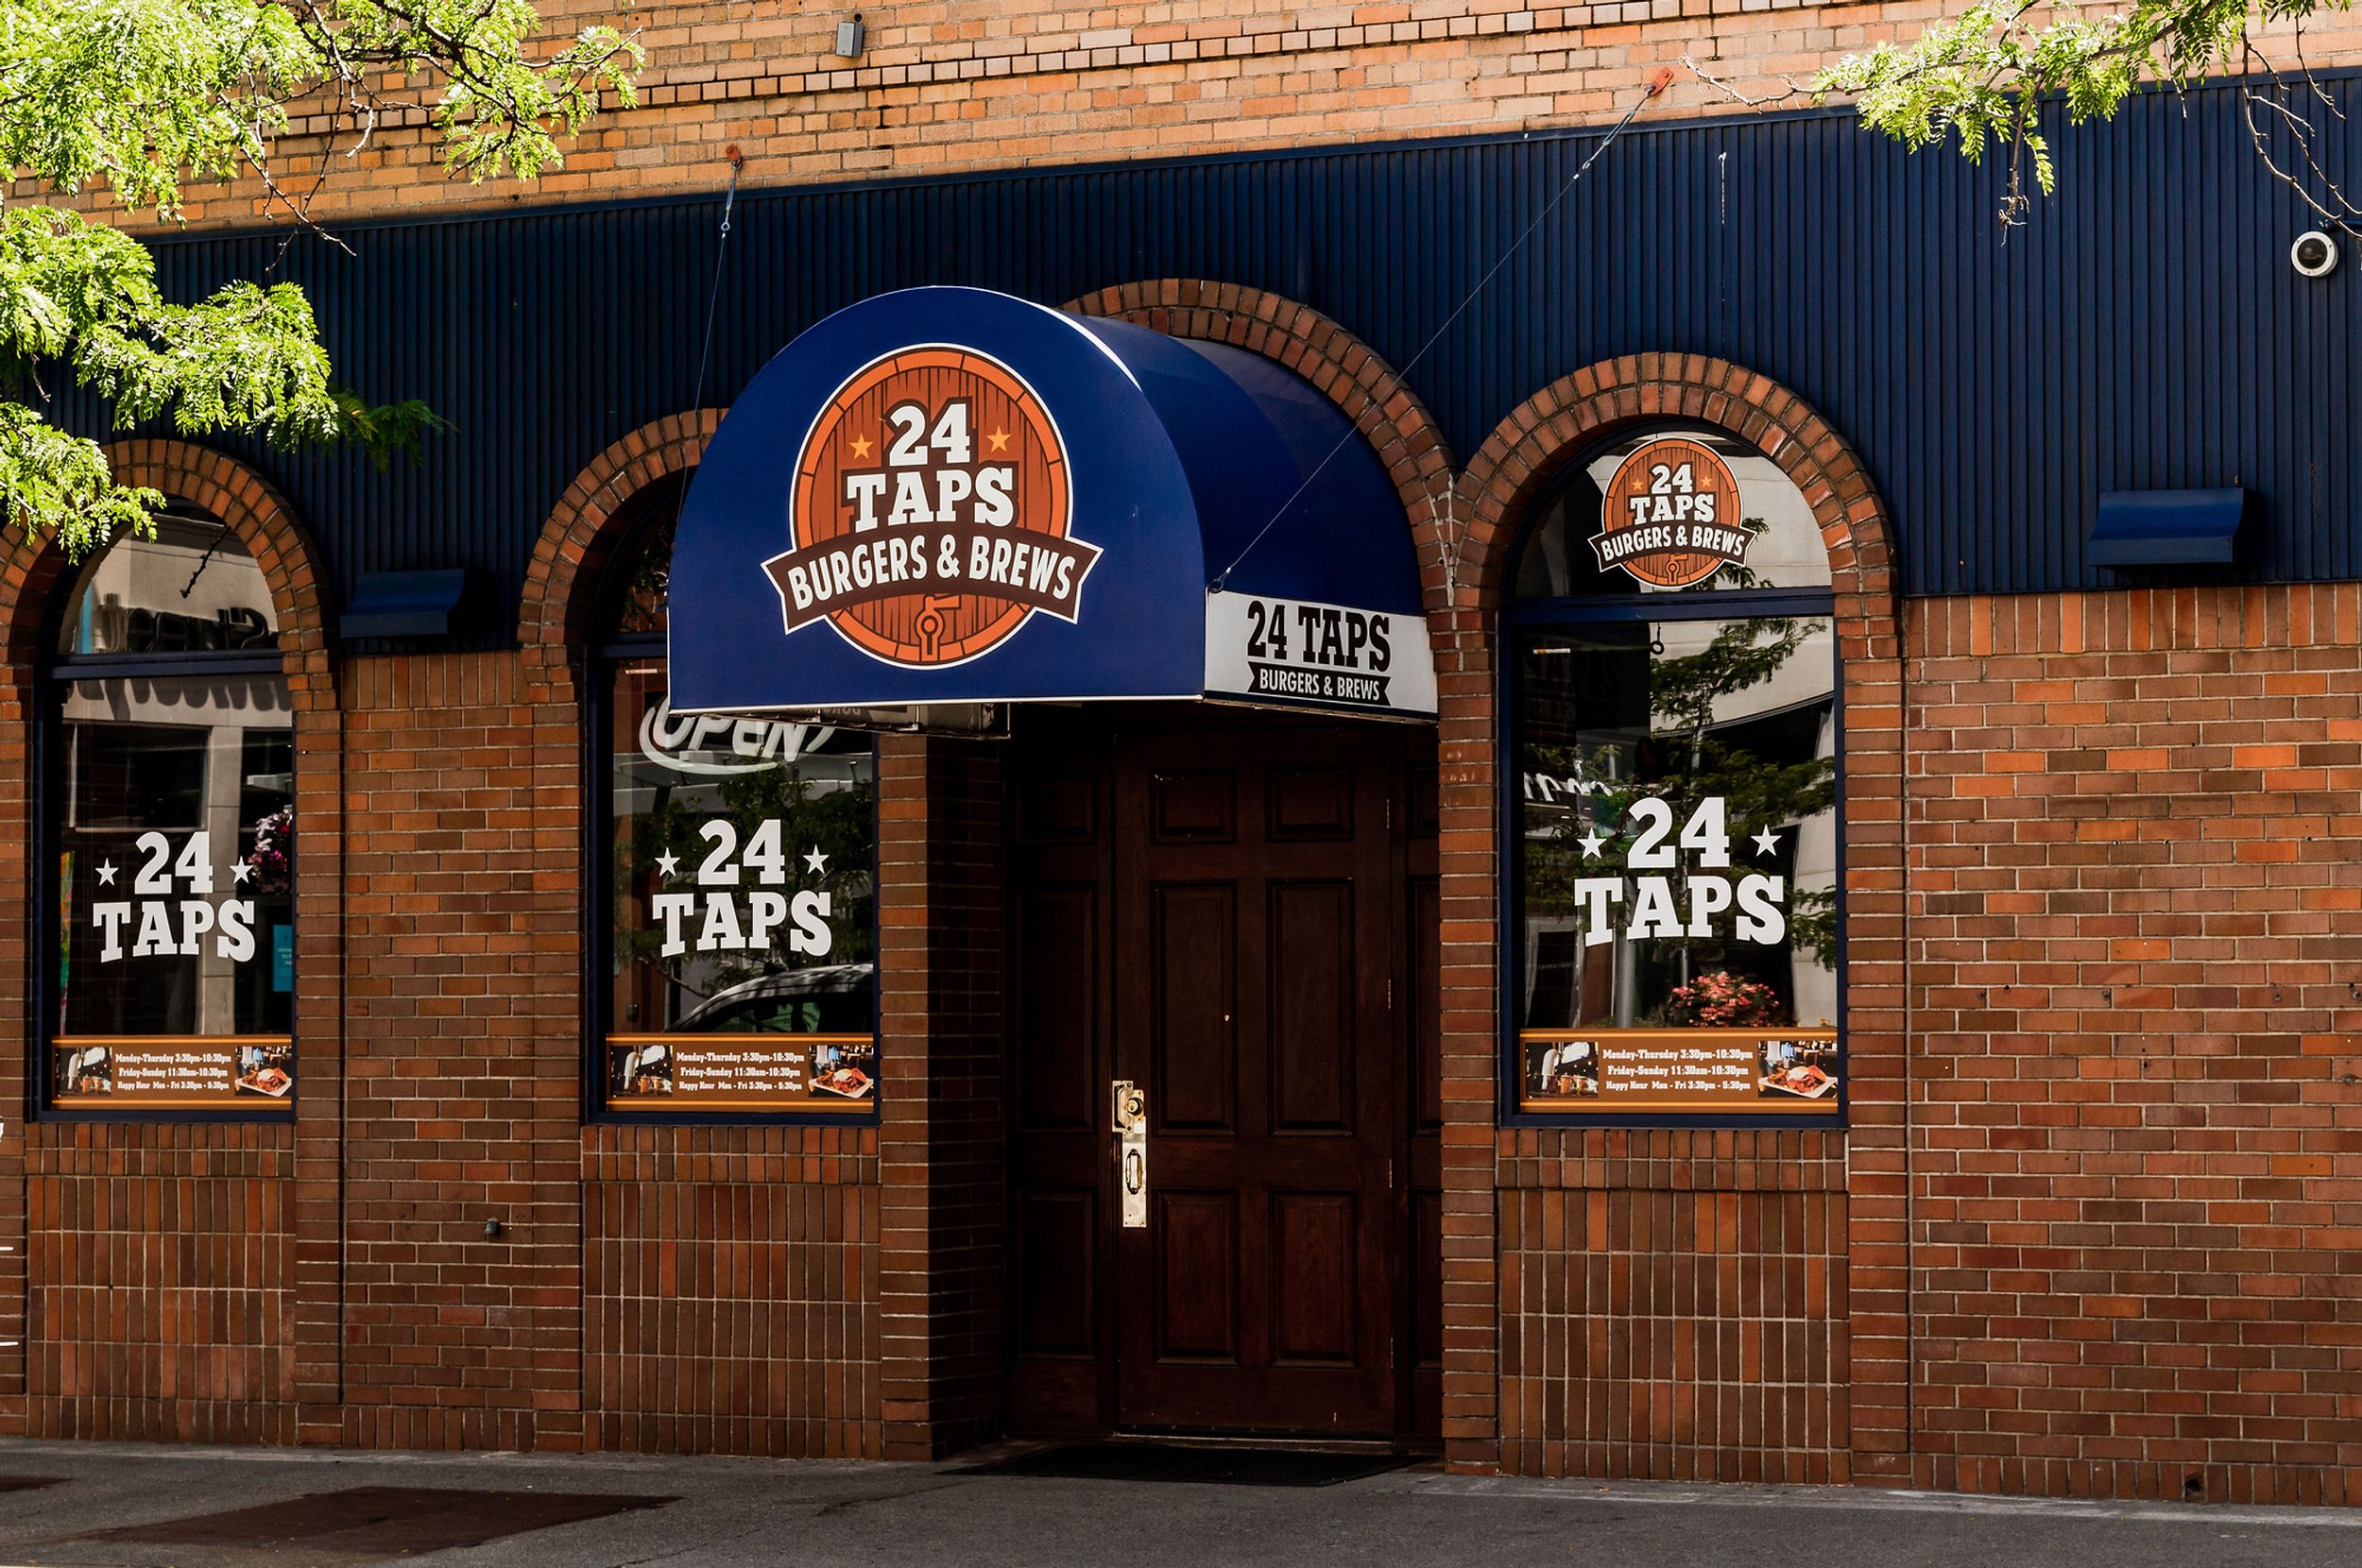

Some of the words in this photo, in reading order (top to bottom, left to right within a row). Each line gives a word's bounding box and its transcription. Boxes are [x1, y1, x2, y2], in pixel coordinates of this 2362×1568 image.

[888, 402, 972, 467] 24
[847, 467, 1014, 534] TAPS
[1630, 493, 1715, 525] TAPS
[1651, 463, 1694, 494] 24
[788, 535, 928, 610] BURGERS
[939, 534, 962, 580] &
[971, 536, 1076, 600] BREWS
[1600, 525, 1672, 563] BURGERS
[1675, 525, 1688, 547] &
[1691, 525, 1745, 557] BREWS
[1247, 600, 1288, 660] 24
[1298, 605, 1391, 673] TAPS
[1259, 669, 1320, 696] BURGERS
[1324, 676, 1333, 696] &
[1337, 676, 1380, 702] BREWS
[134, 831, 214, 894] 24
[698, 819, 785, 885] 24
[1627, 796, 1730, 868] 24
[93, 899, 256, 963] TAPS
[653, 890, 832, 958] TAPS
[1574, 874, 1786, 946] TAPS
